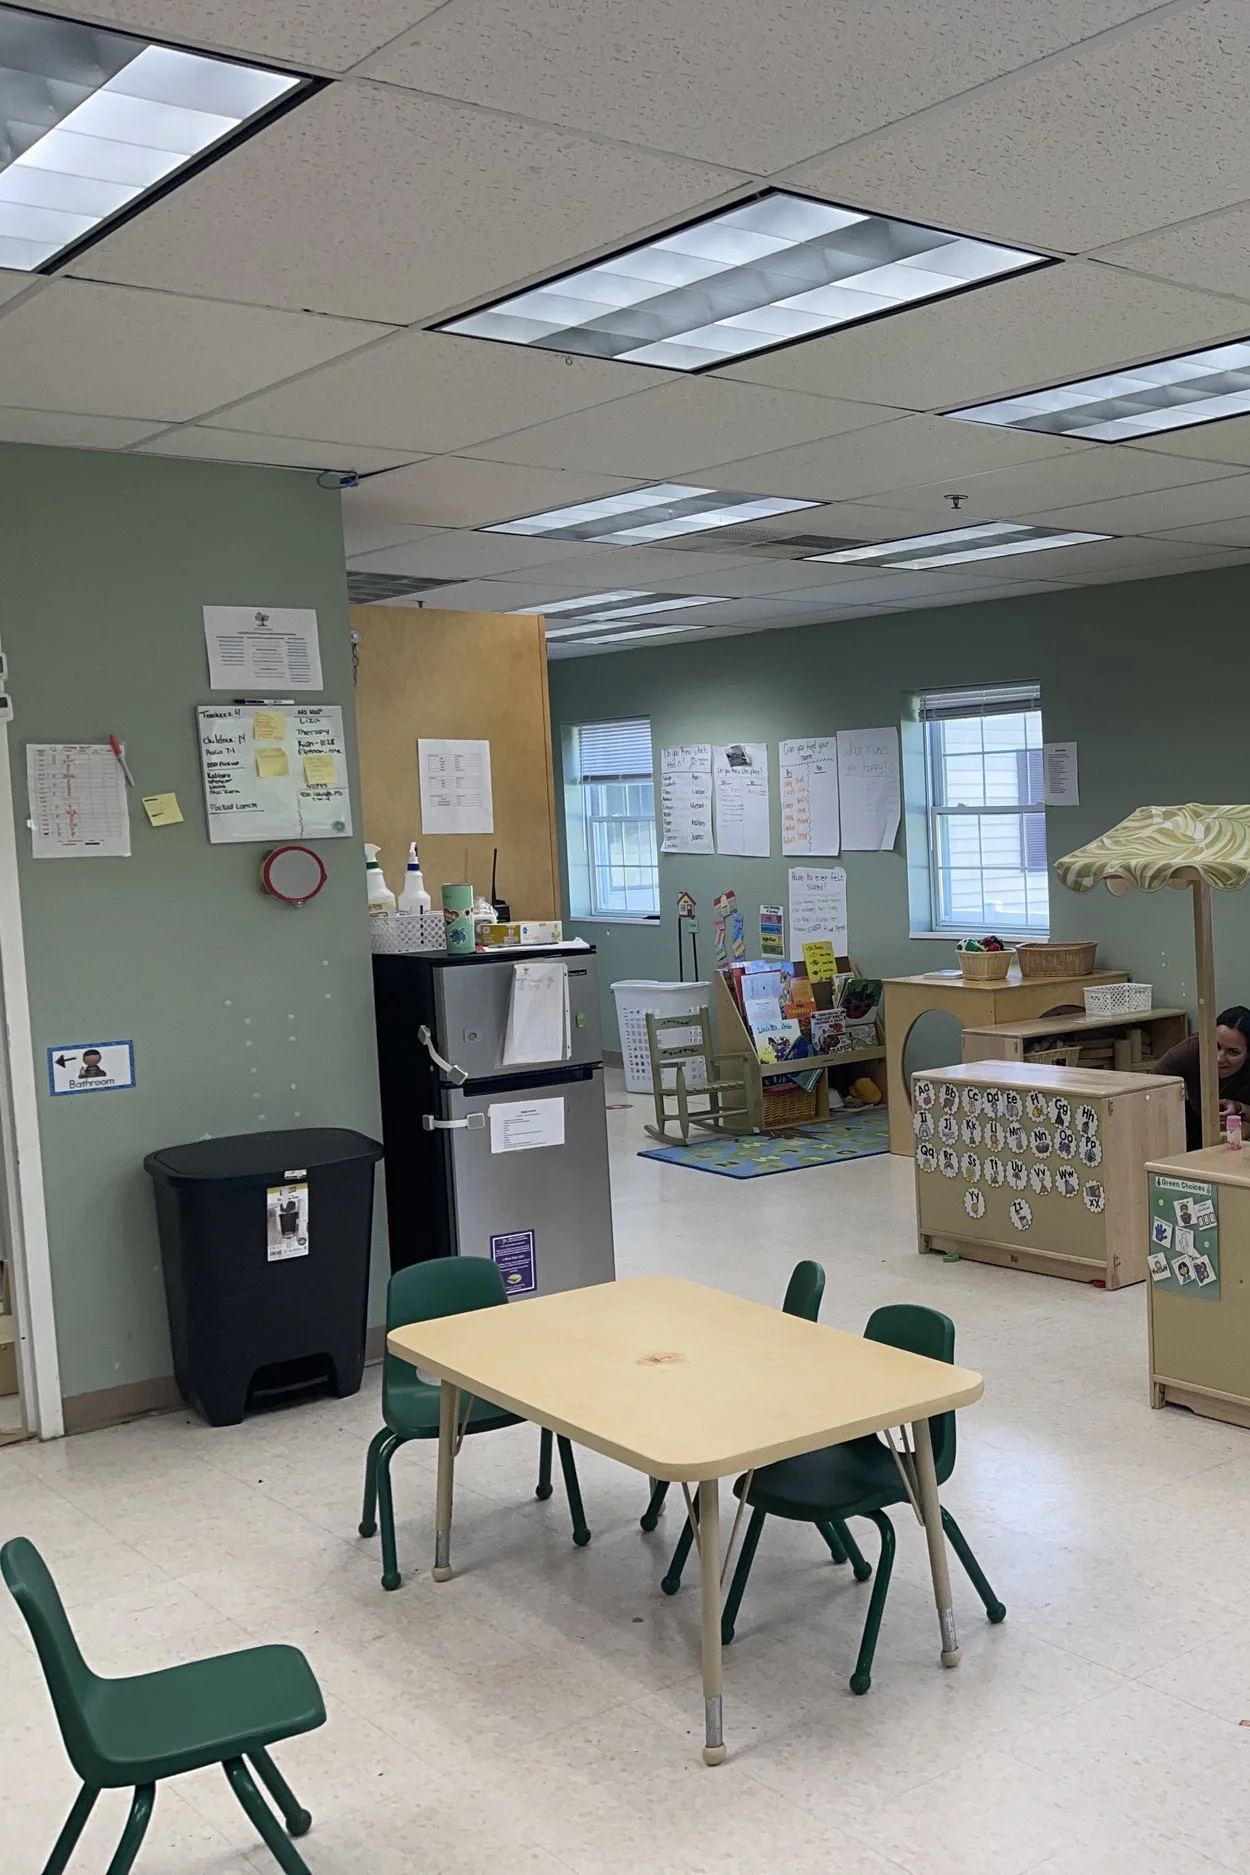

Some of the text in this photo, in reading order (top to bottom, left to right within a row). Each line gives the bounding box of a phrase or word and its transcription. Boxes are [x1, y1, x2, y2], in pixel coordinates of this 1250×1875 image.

[69, 1078, 115, 1089] Bathroom
[918, 1083, 1095, 1123] Aa Bb Cc Dd Ee Ff Gg Hh
[919, 1112, 1097, 1150] Ii Jj Kk Ll Mm Nn Oo Pp
[920, 1144, 1074, 1181] Qq Rr Ss Tt Uu Vv Ww
[1161, 1178, 1206, 1193] Green Choices
[968, 1190, 980, 1204] Yy
[1012, 1201, 1024, 1214] Zz
